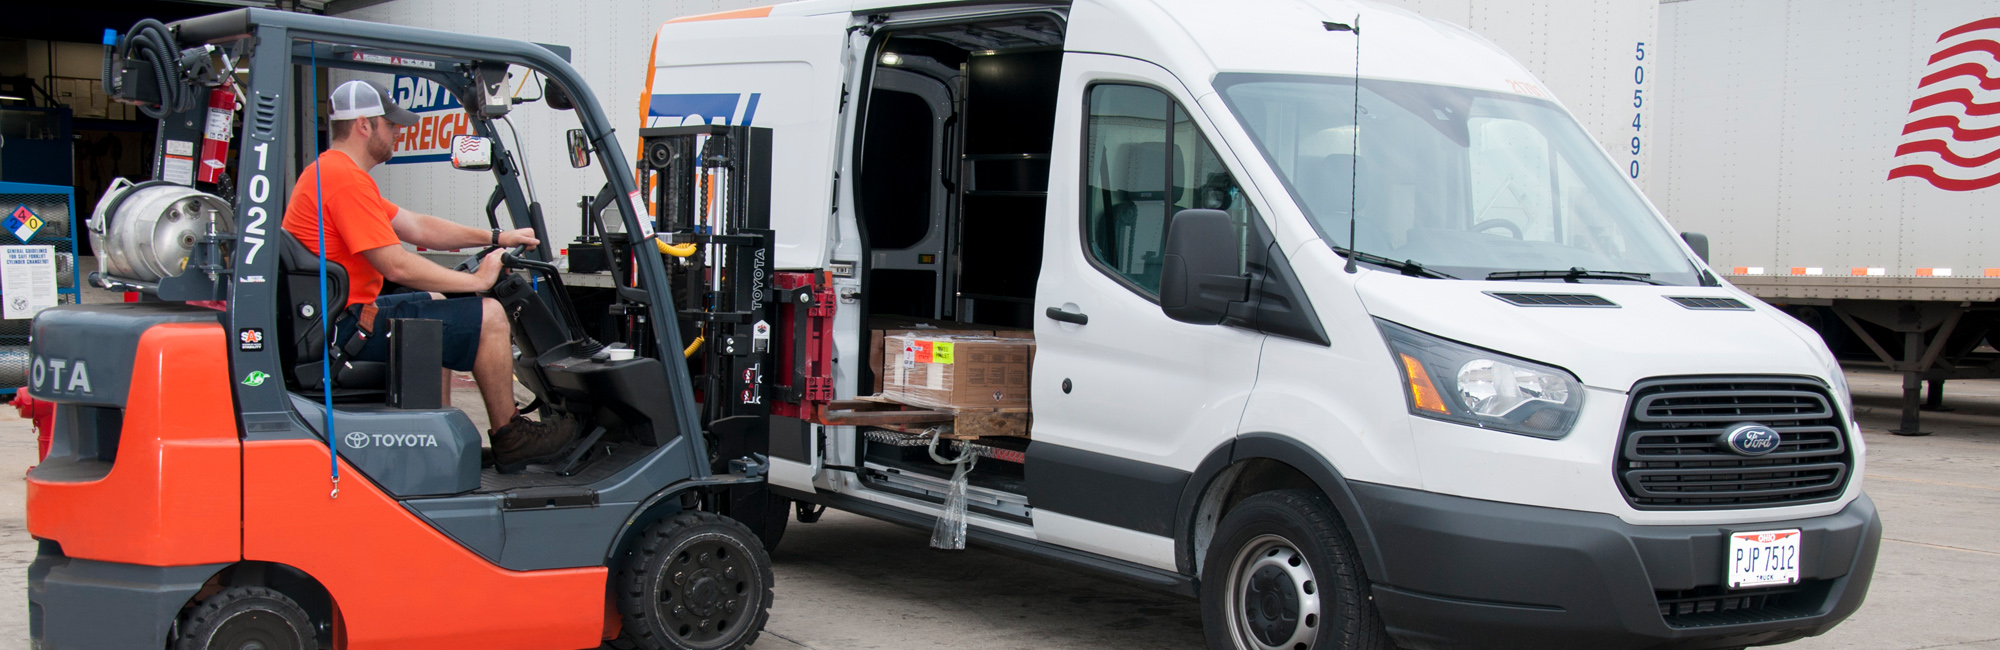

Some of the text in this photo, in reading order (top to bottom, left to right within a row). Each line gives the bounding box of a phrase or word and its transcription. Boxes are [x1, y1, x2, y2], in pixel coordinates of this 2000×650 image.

[397, 75, 462, 110] DAY
[1630, 42, 1645, 179] 505490
[393, 112, 477, 152] FREIGH
[243, 143, 270, 265] 1027
[9, 217, 18, 229] 2
[18, 209, 26, 220] 4
[29, 218, 38, 230] 0
[752, 248, 766, 310] TOYOTA
[241, 329, 263, 343] SAS
[372, 434, 438, 447] TOYOTA
[1744, 430, 1772, 448] Ford
[1758, 533, 1776, 543] OHIO
[1735, 544, 1795, 574] PJP 7512
